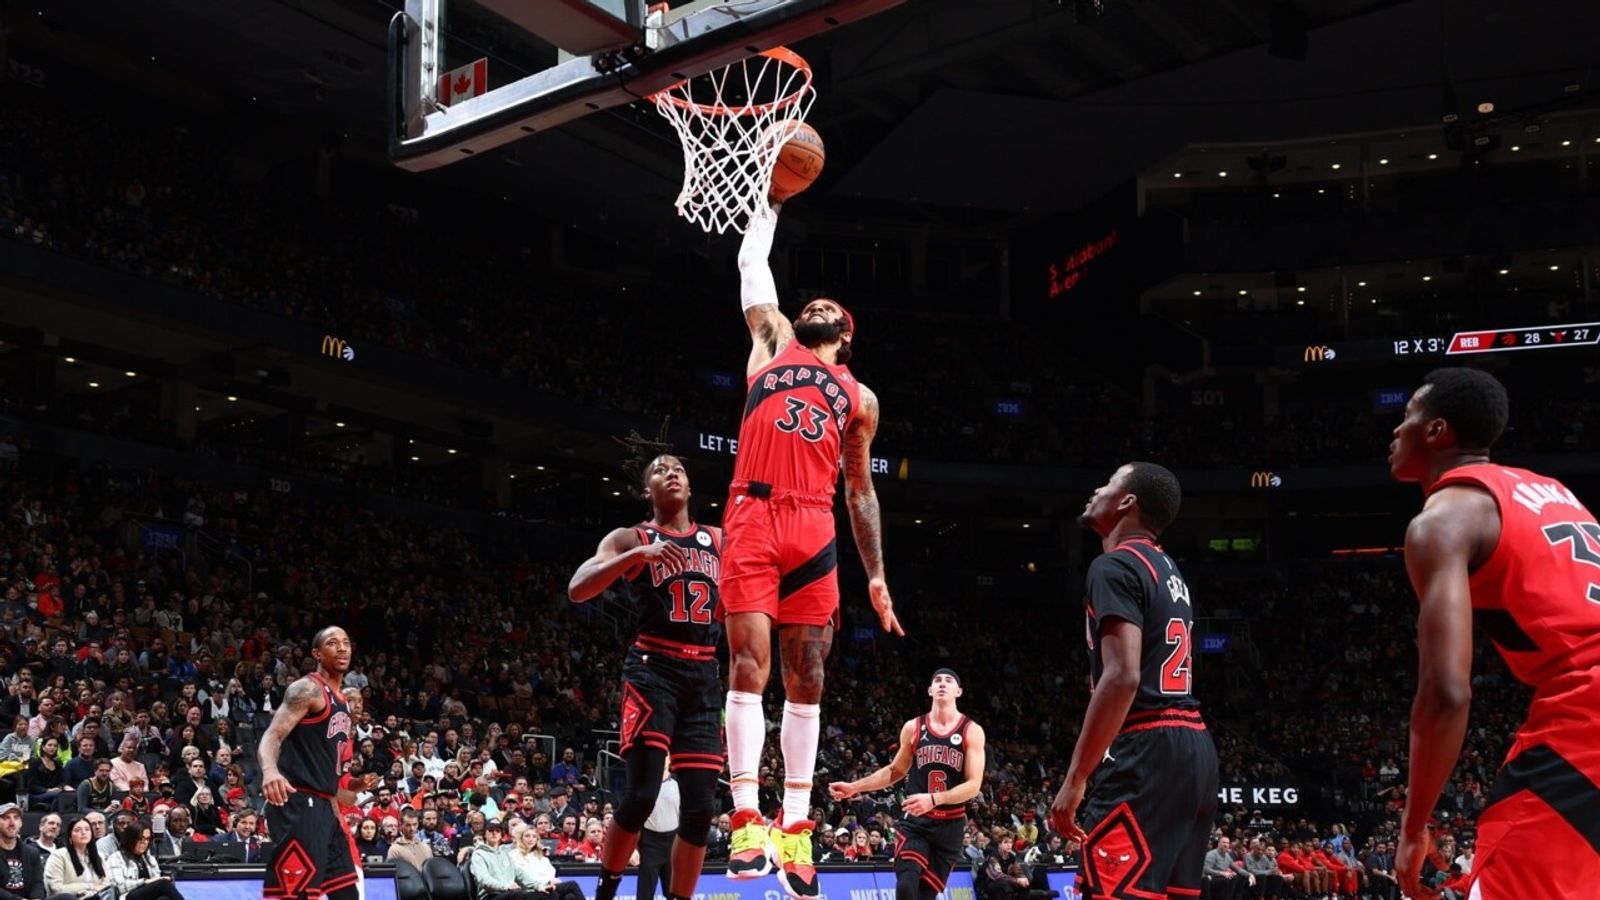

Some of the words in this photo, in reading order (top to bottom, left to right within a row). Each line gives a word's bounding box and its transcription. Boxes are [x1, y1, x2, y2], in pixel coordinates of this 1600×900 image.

[1394, 340, 1409, 354] 12
[1414, 339, 1424, 353] X
[1460, 337, 1480, 349] REB
[1524, 332, 1541, 345] 28
[1573, 329, 1589, 341] 27
[763, 367, 848, 430] RAPTORS
[776, 395, 831, 442] 33
[700, 433, 724, 452] LET
[727, 438, 738, 455] 'E
[871, 457, 888, 474] ER
[270, 478, 291, 493] 120
[668, 579, 711, 625] 12
[1204, 638, 1226, 649] IBM
[1160, 617, 1193, 695] 2
[915, 744, 964, 773] CHICAGO
[928, 770, 948, 794] 6
[1217, 787, 1244, 804] HE
[1252, 787, 1299, 804] KEG
